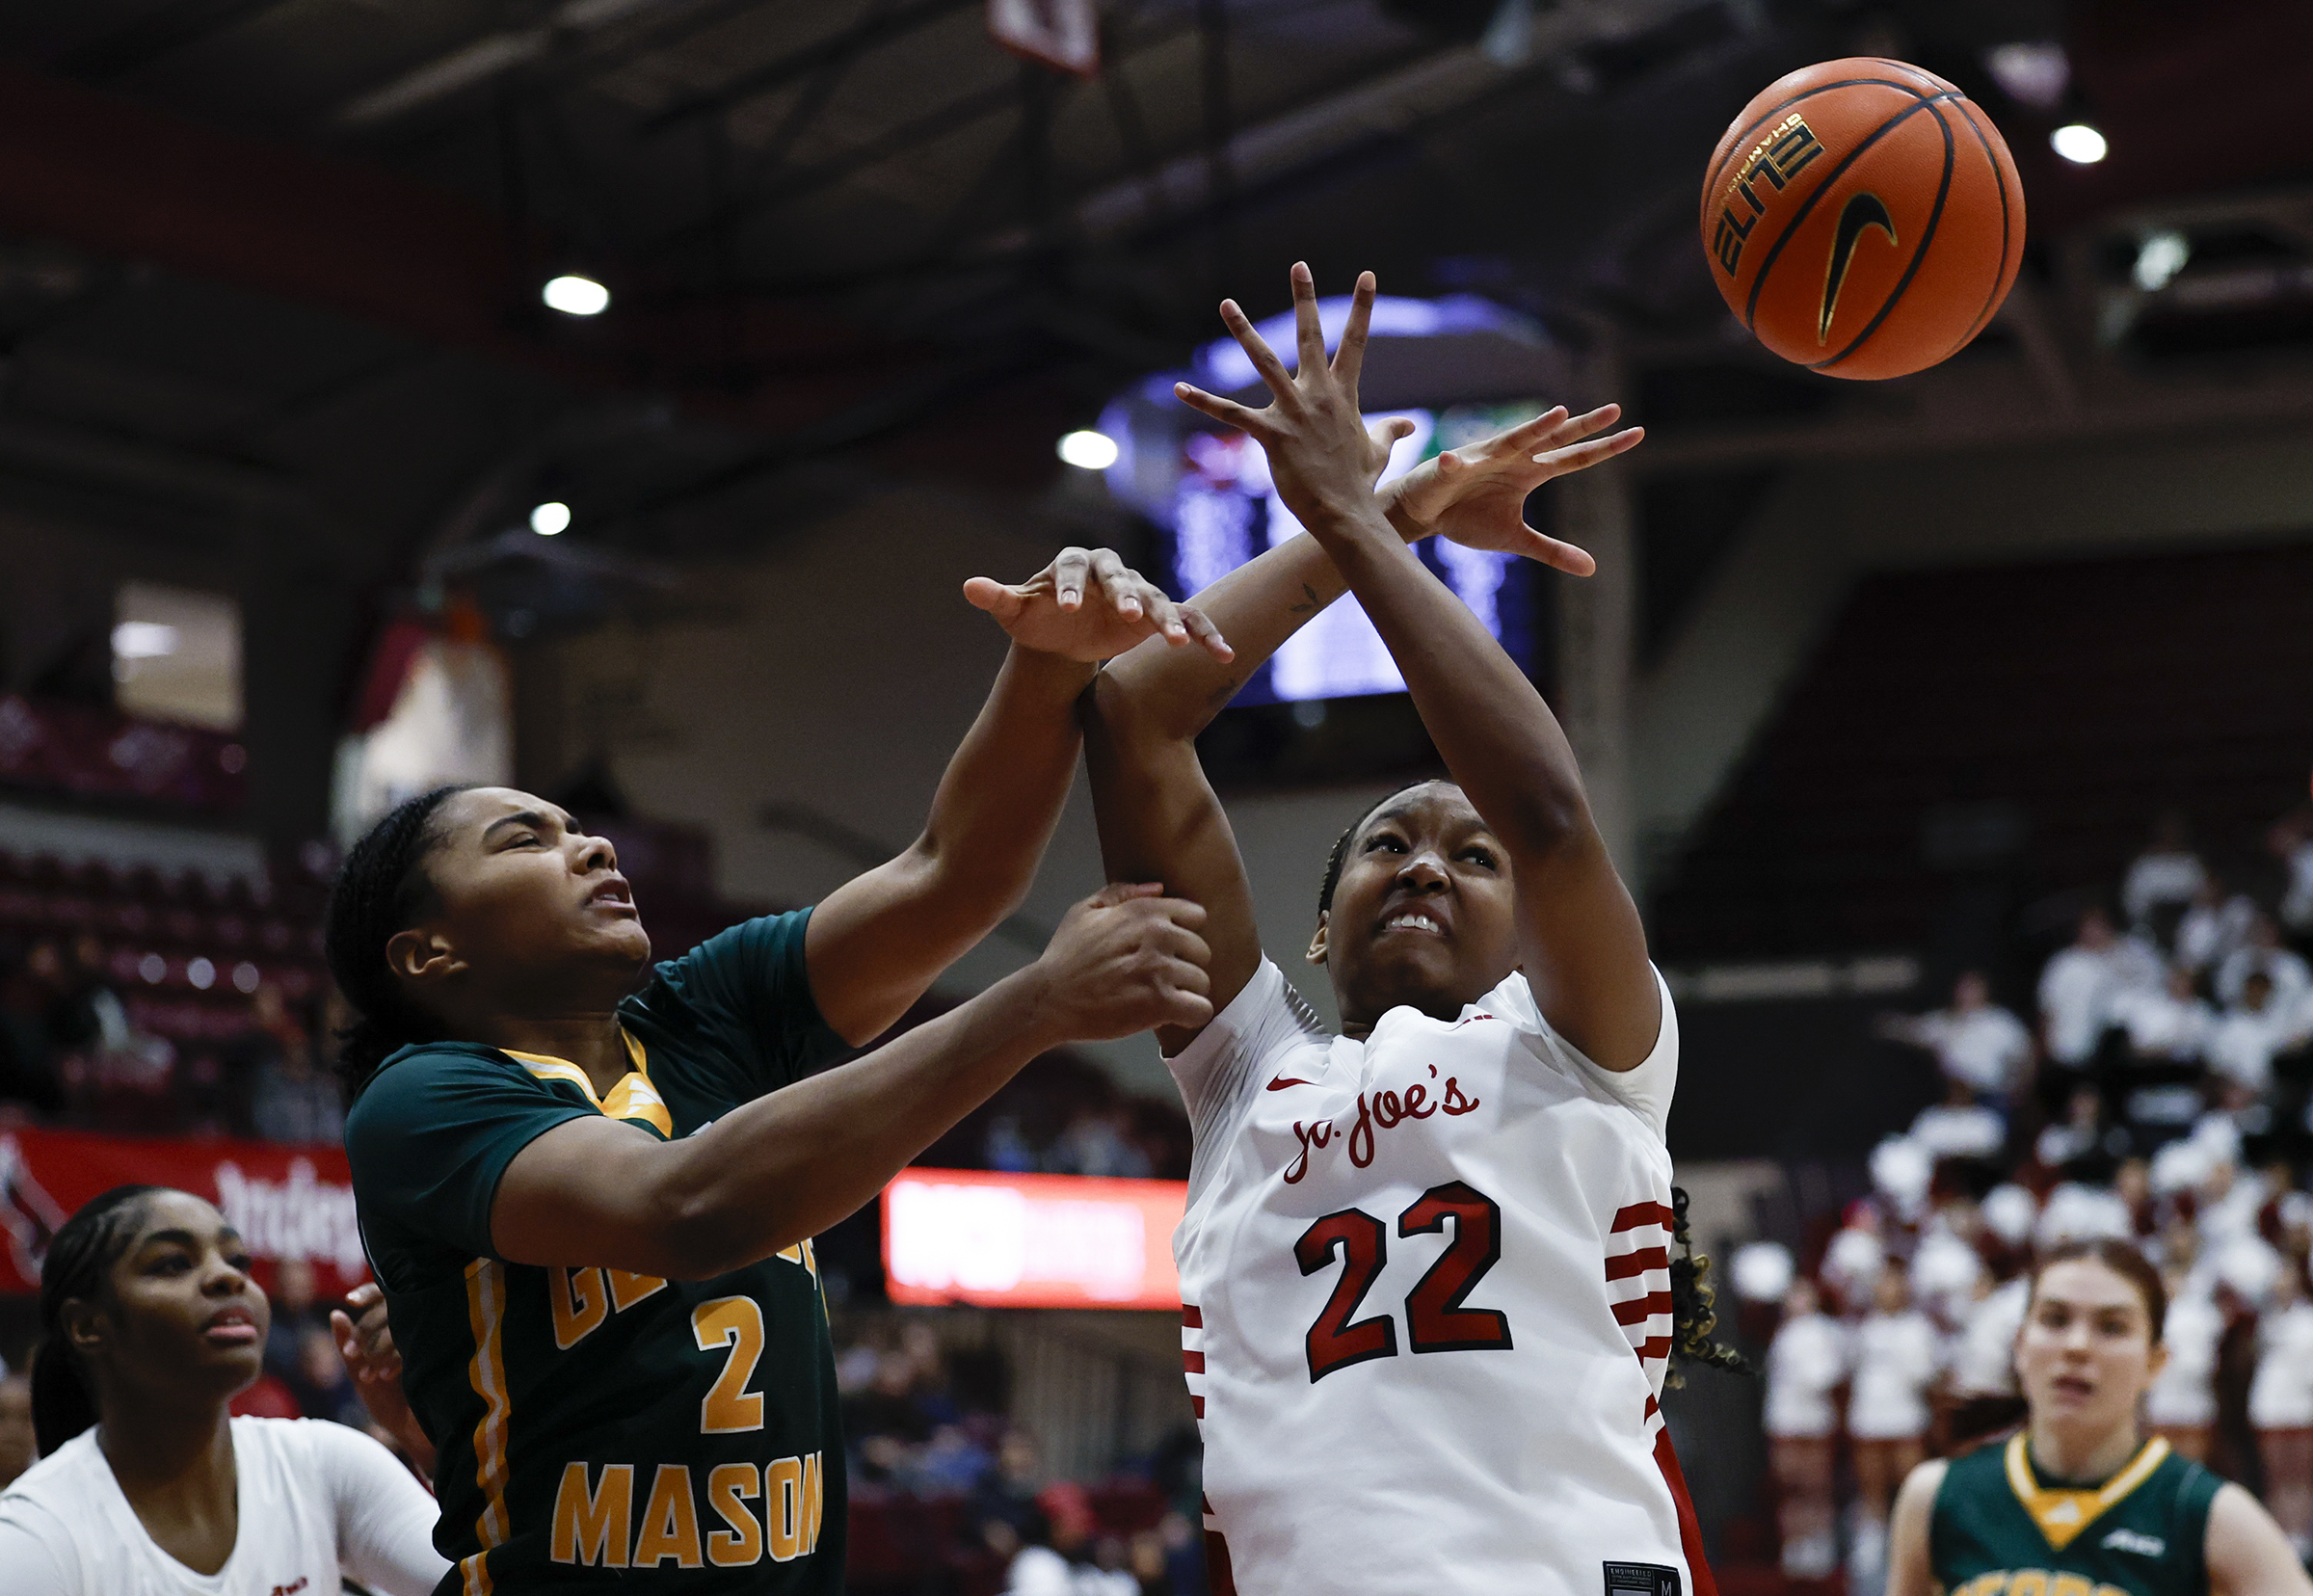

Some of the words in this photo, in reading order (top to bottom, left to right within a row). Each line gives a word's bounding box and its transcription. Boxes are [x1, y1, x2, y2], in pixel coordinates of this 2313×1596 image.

[1714, 120, 1826, 279] ELITE
[1348, 1063, 1480, 1169] Joe's
[1293, 1180, 1514, 1384] 22
[690, 1294, 765, 1434] 2
[549, 1450, 824, 1569] MASON
